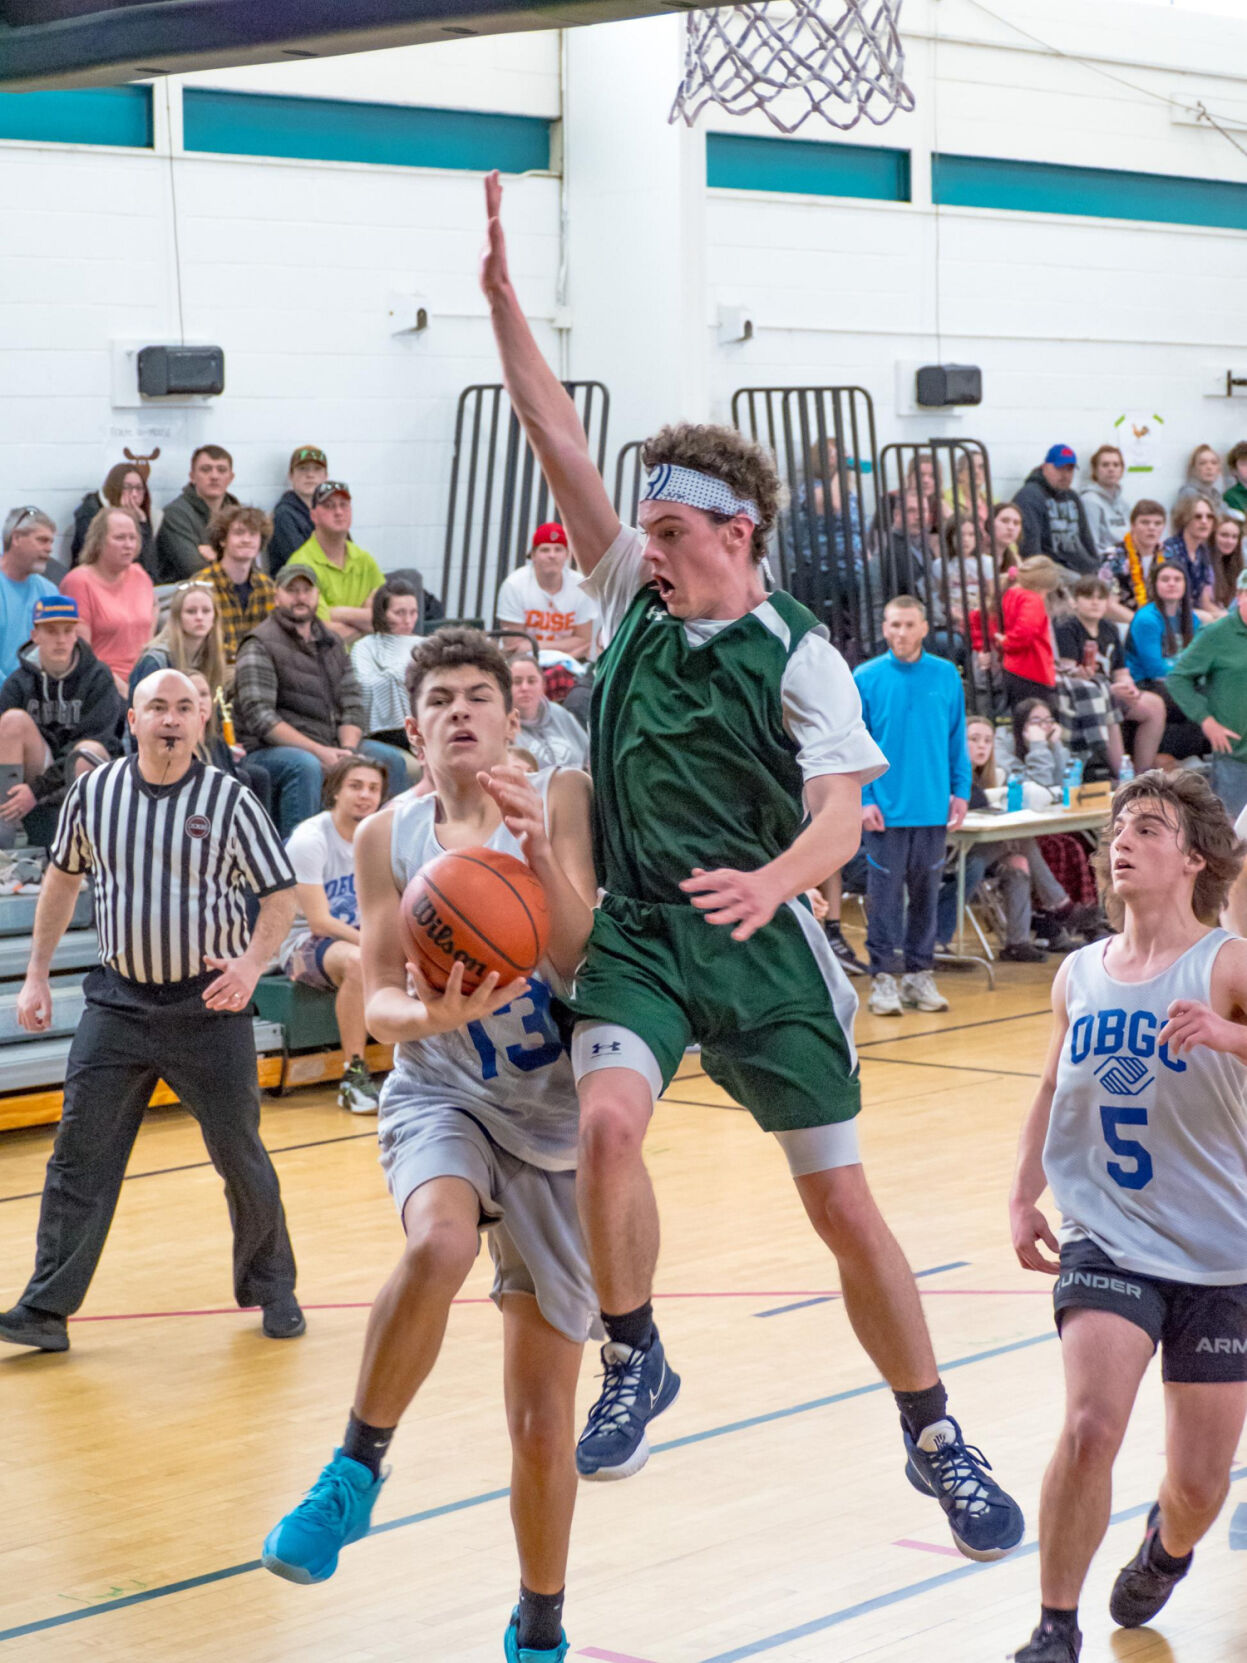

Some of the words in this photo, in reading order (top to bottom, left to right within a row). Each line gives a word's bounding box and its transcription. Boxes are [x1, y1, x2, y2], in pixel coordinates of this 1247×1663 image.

[412, 896, 487, 976] Wilson
[467, 977, 562, 1081] 13
[1100, 1106, 1153, 1190] 5
[1057, 1272, 1142, 1299] UNDER
